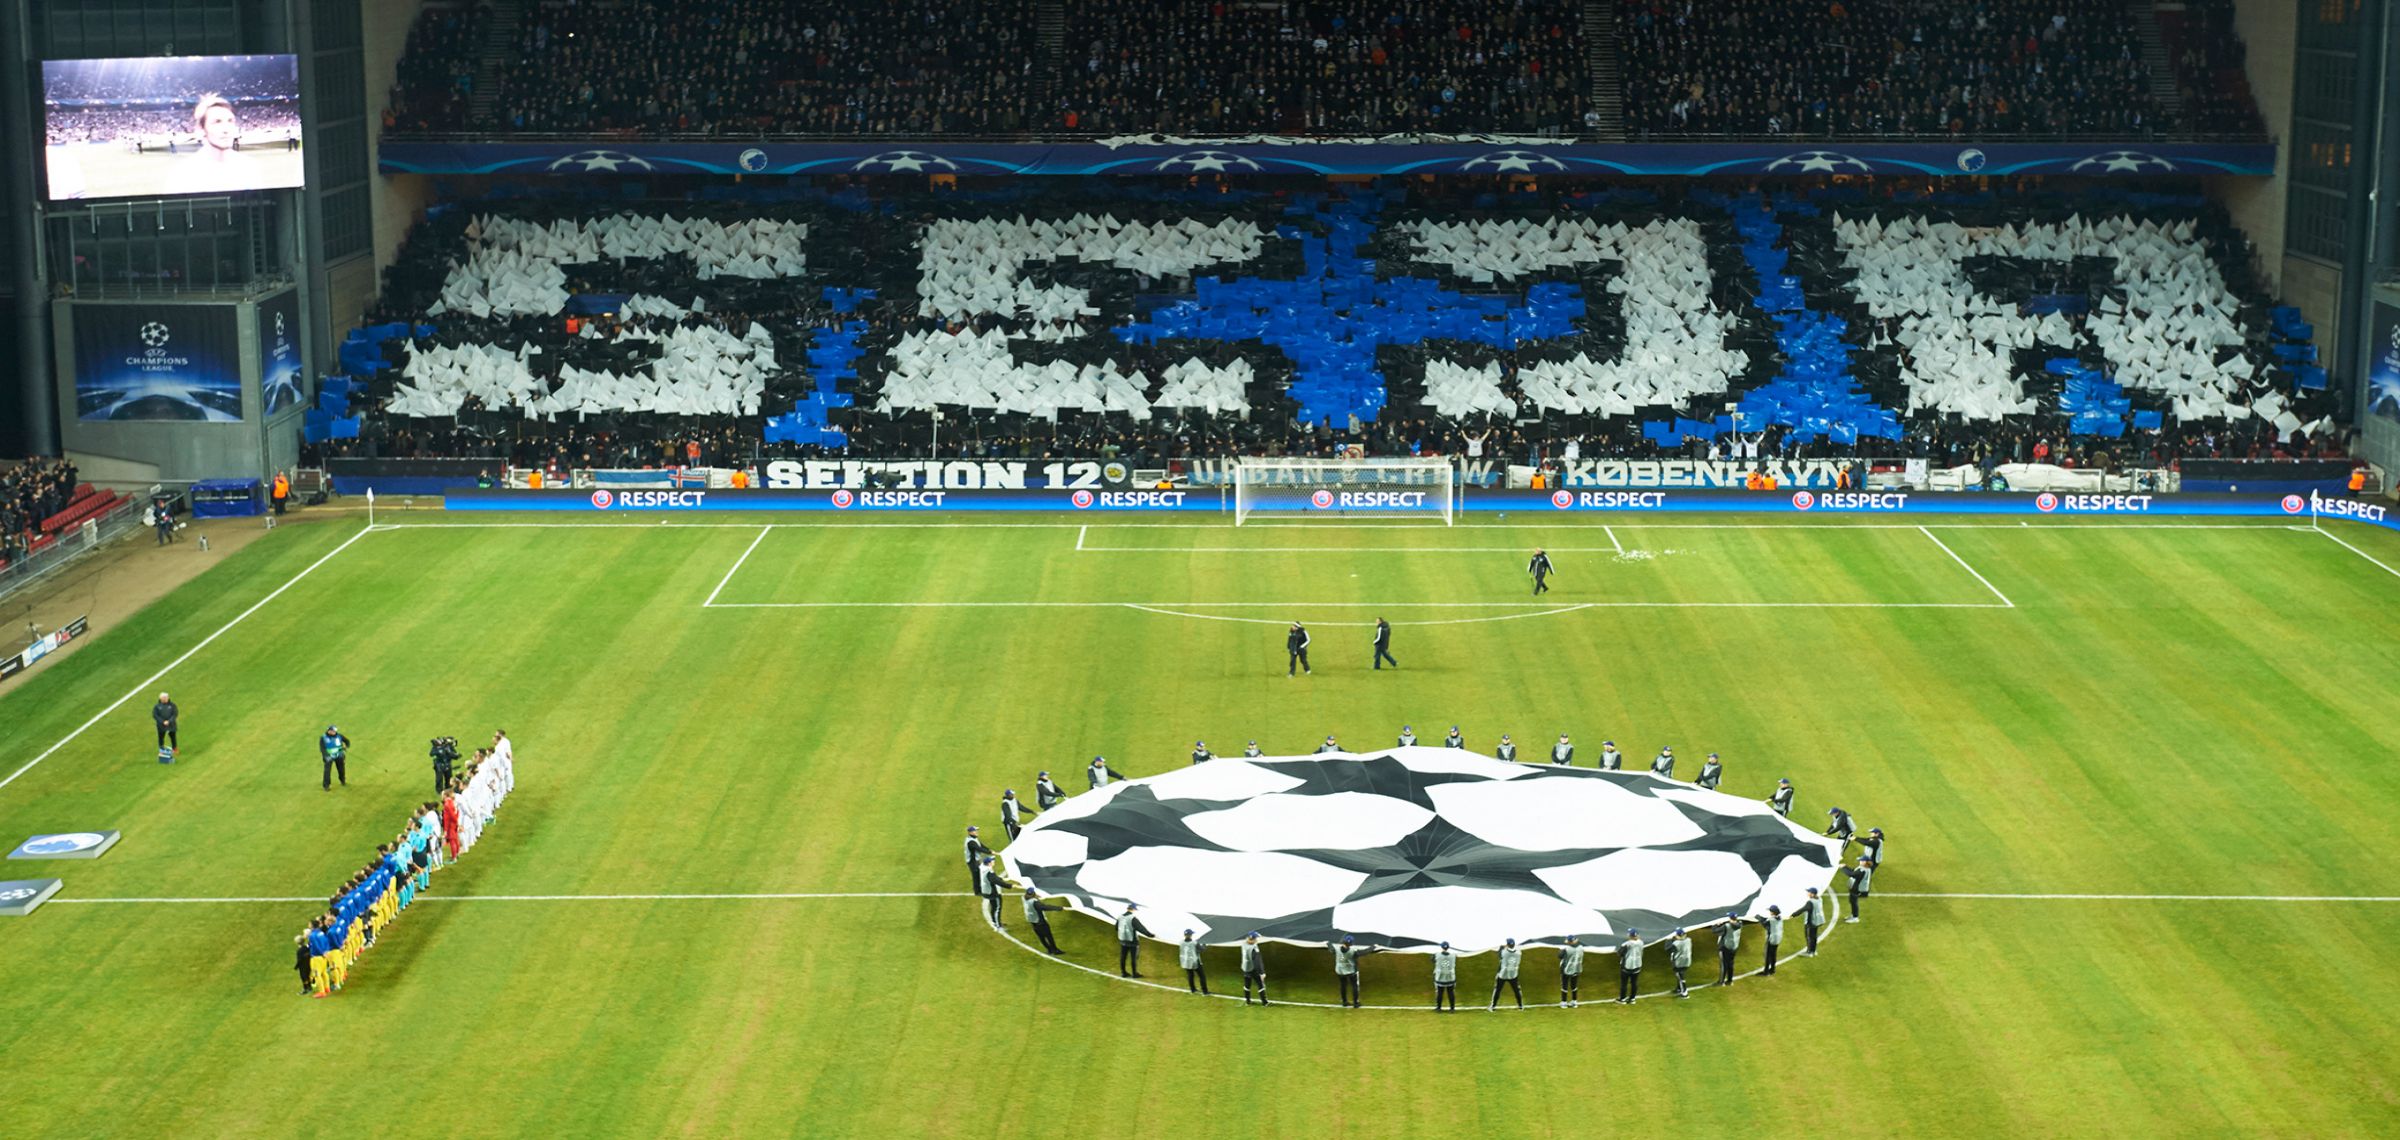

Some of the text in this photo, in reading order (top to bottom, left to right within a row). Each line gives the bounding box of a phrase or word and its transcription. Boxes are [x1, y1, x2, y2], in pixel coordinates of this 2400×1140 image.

[126, 357, 189, 366] CHAMPIONS
[766, 460, 1103, 489] SEKTION 12
[1193, 459, 1323, 484] URBAN
[620, 491, 706, 507] RESPECT
[860, 491, 946, 507] RESPECT
[1100, 491, 1186, 507] RESPECT
[1340, 491, 1426, 507] RESPECT
[1580, 492, 1666, 507] RESPECT
[1820, 493, 1908, 508] RESPECT
[2064, 495, 2152, 511] RESPECT
[2311, 498, 2386, 522] RESPECT
